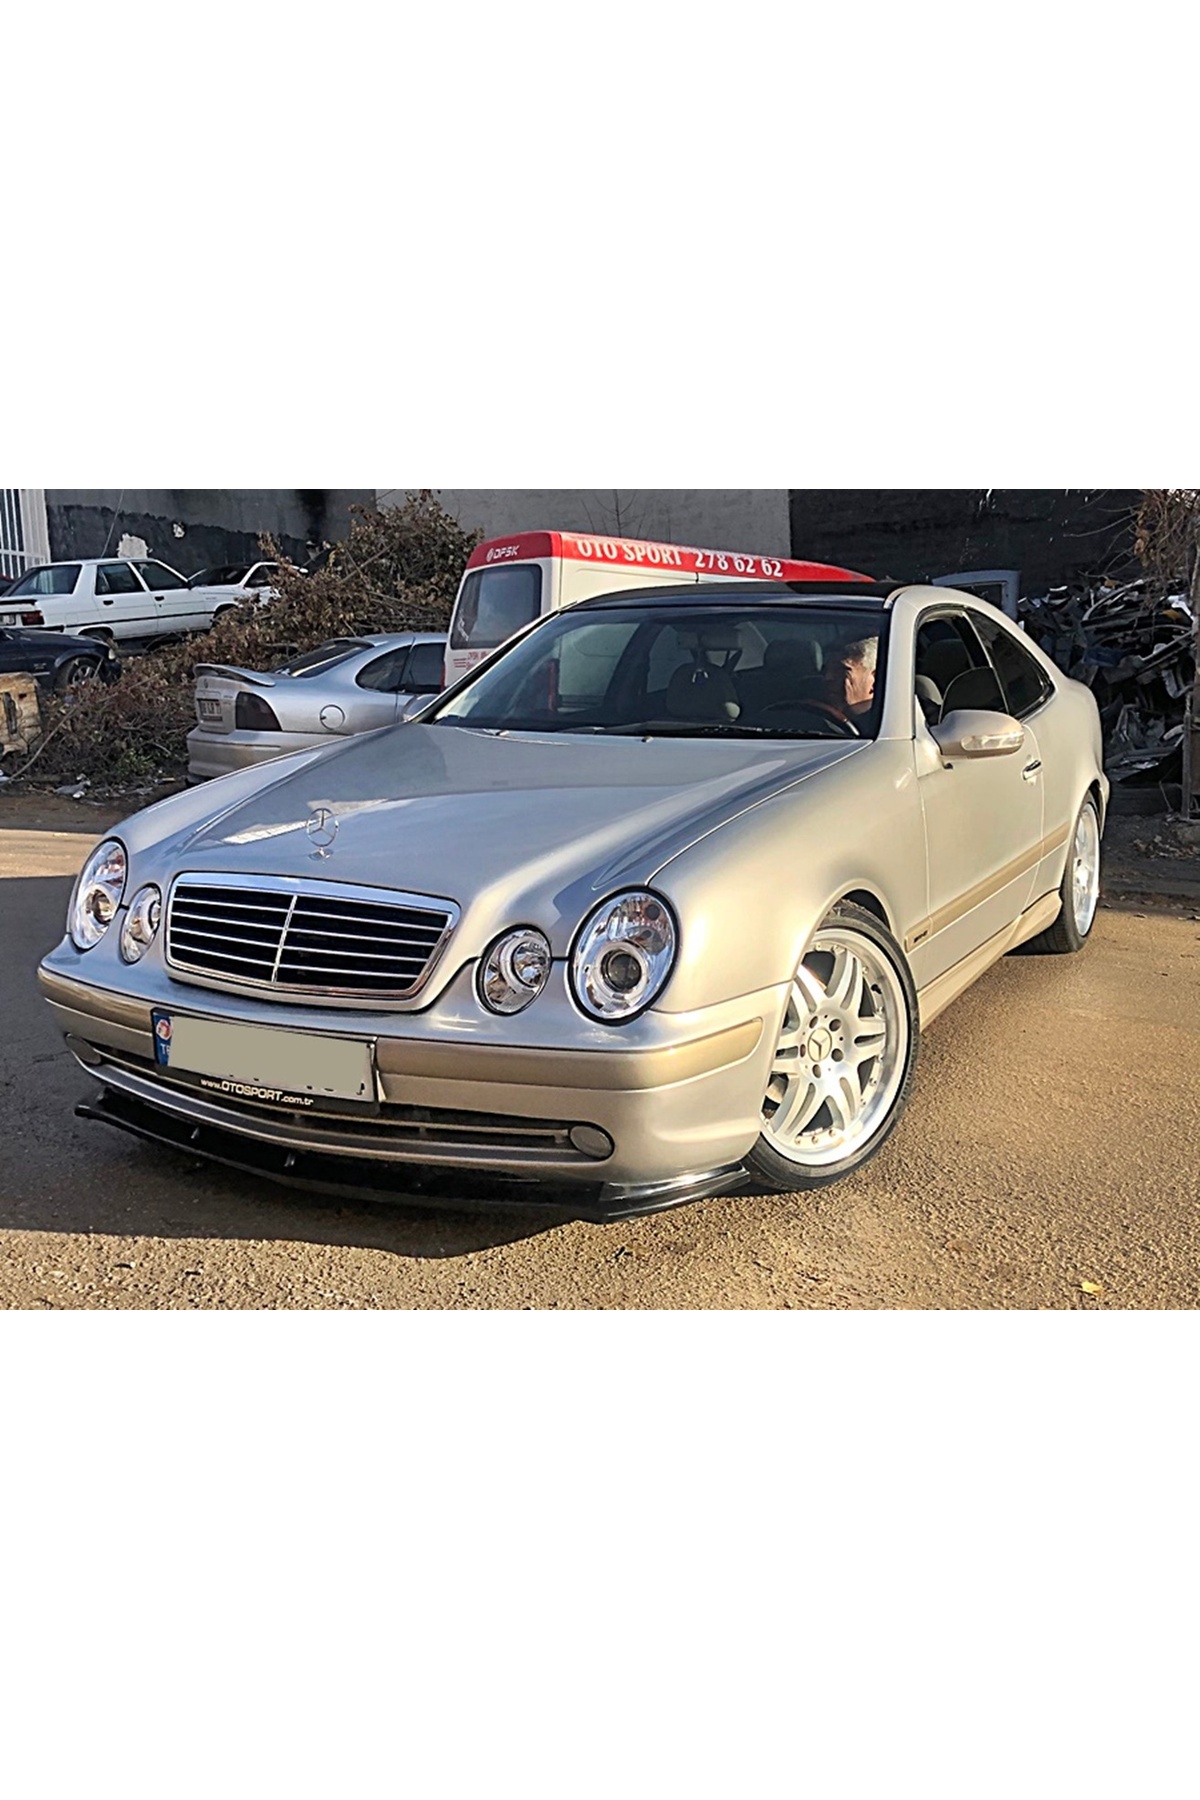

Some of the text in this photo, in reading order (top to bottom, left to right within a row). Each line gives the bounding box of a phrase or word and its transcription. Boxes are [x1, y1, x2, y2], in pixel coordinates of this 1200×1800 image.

[493, 545, 520, 560] DFSK
[577, 539, 783, 577] OTO SPORT 278 62 62
[200, 1079, 314, 1106] www.OTOSPORT.com.tr
